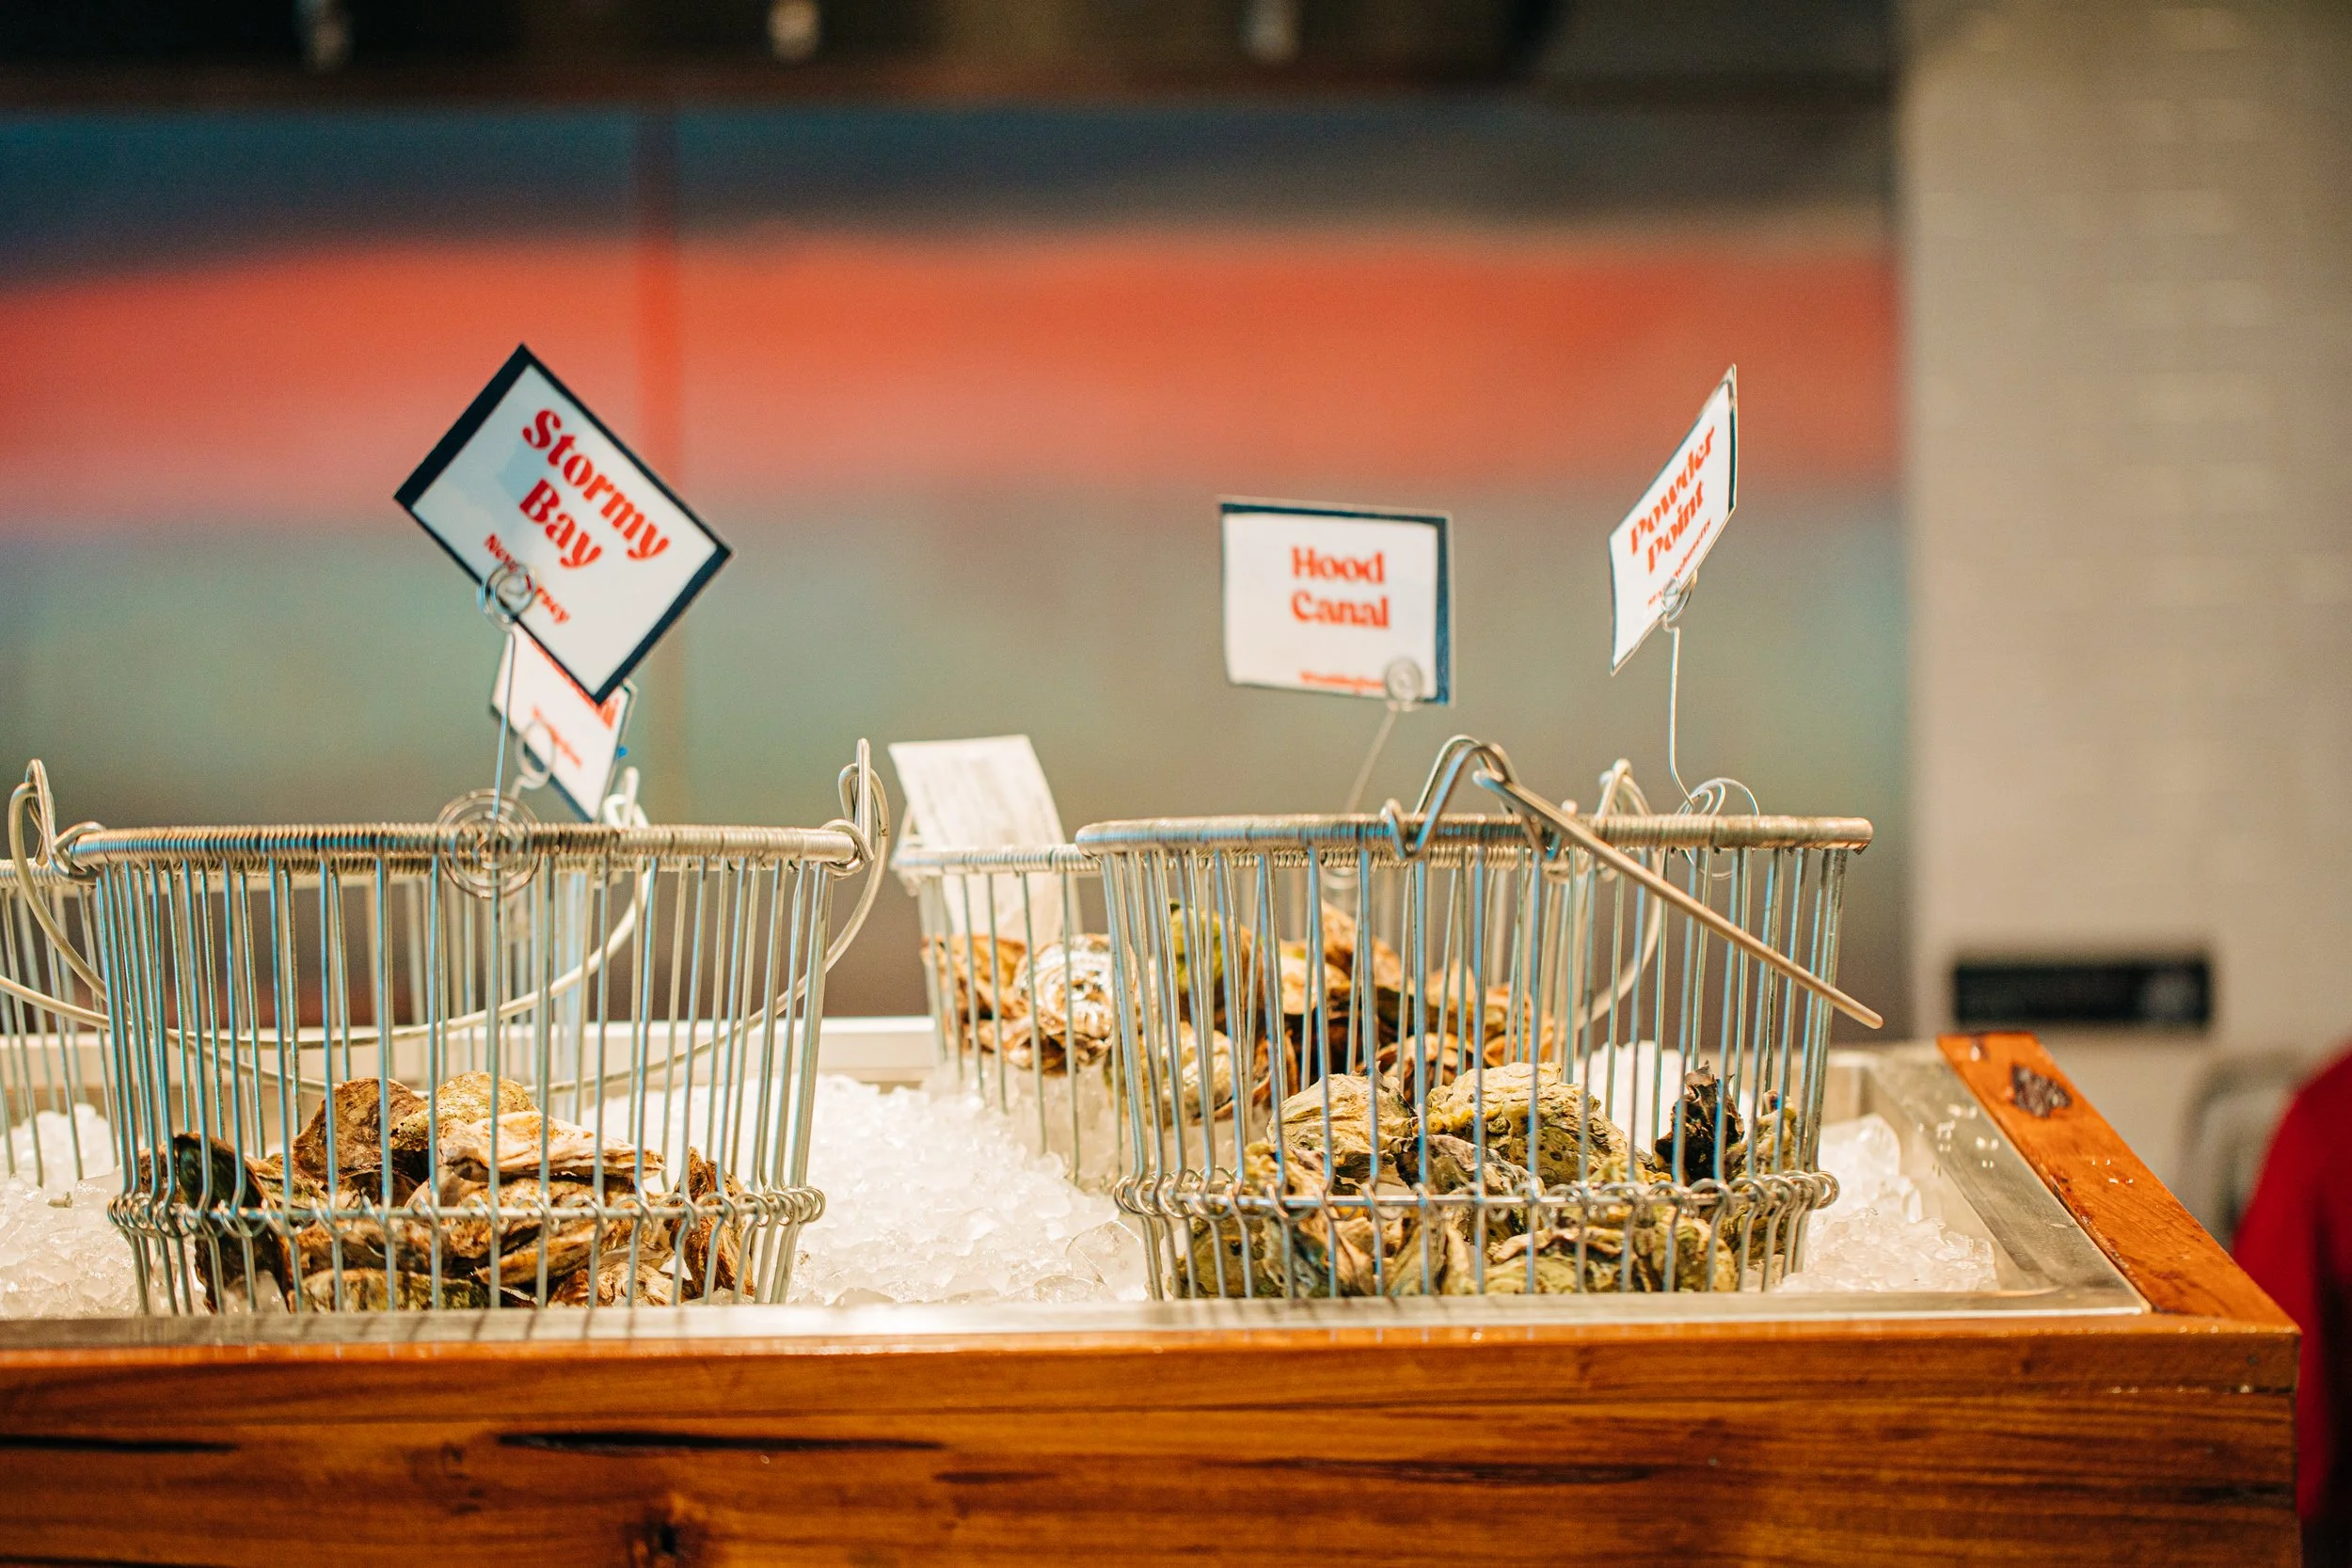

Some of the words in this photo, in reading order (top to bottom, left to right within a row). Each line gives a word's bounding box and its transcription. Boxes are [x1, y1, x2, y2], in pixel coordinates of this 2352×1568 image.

[518, 478, 602, 570] Bay
[522, 408, 670, 562] Stormy
[1630, 424, 1715, 557] Powder
[1647, 479, 1704, 576] Point
[522, 570, 571, 626] rsey
[1291, 590, 1391, 630] Canal
[1292, 545, 1385, 585] Hood
